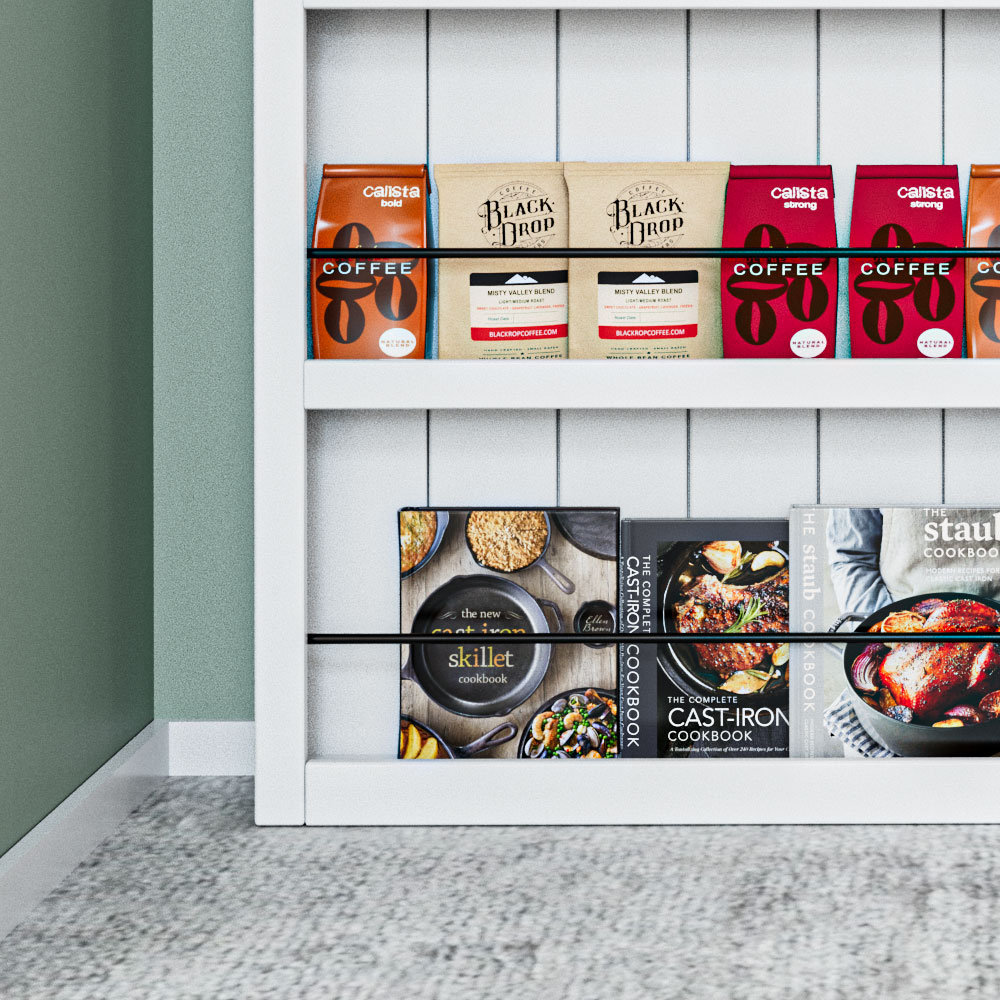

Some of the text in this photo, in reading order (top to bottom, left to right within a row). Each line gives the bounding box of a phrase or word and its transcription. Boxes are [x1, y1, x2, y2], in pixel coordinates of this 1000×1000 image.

[381, 199, 402, 207] bold
[784, 201, 817, 211] strong
[910, 201, 943, 210] strong
[477, 197, 553, 231] BLACK
[606, 197, 682, 230] BLACK
[501, 217, 555, 246] DROP
[630, 217, 684, 246] DROP
[323, 262, 412, 275] COFFEE
[733, 263, 823, 276] COFFEE
[860, 263, 950, 275] COFFEE
[923, 508, 947, 517] THE
[802, 545, 821, 601] staub
[642, 555, 651, 634] THE COMPLET
[461, 609, 478, 618] the
[586, 615, 608, 624] Ellen
[582, 623, 611, 632] Brown
[448, 646, 514, 668] skillet
[459, 674, 508, 684] cookbook
[626, 644, 640, 748] COOKBOOK
[667, 696, 738, 704] THE COMPLETE
[668, 707, 789, 727] CAST-IRON
[667, 730, 753, 742] COOKBOOK
